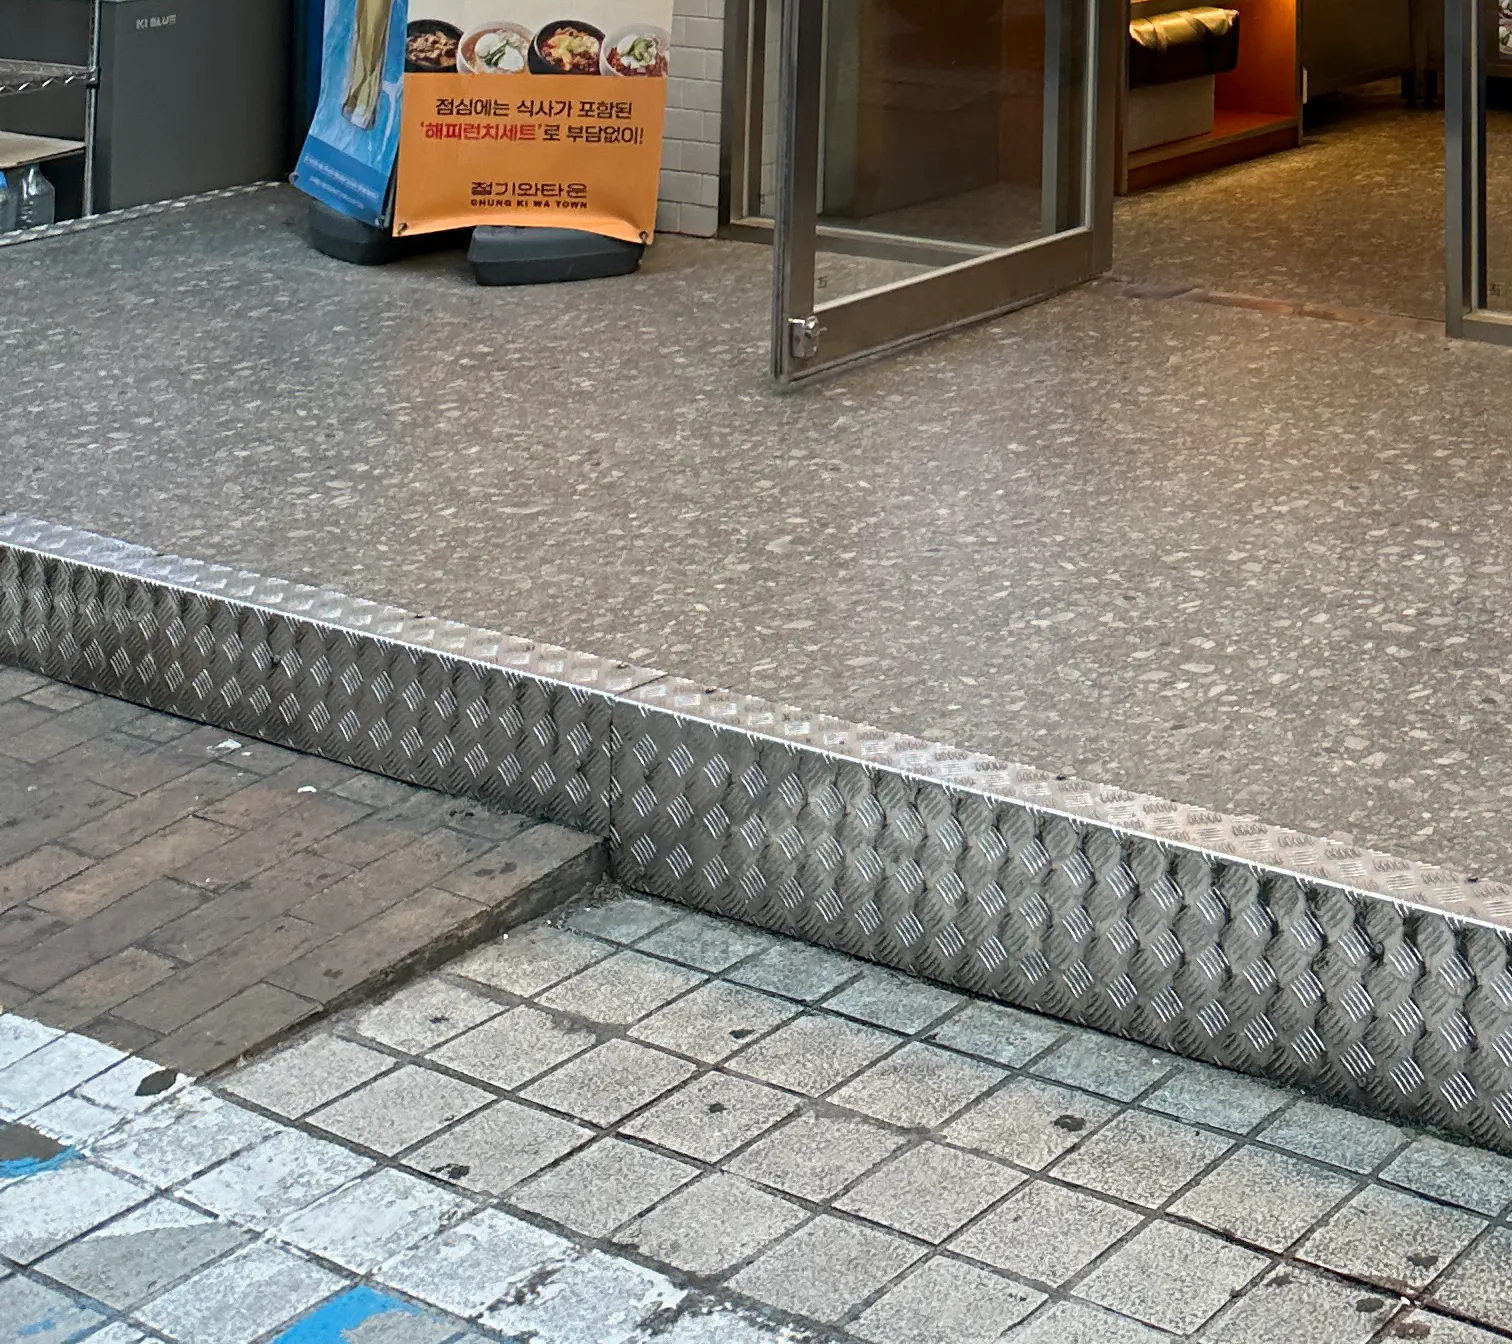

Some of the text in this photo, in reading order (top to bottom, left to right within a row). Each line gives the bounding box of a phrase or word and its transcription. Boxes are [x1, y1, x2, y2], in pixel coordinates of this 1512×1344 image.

[436, 99, 633, 119] 점심에는 식사가 포함된
[565, 124, 644, 144] 부담없이!
[470, 181, 588, 198] 청기와타운
[470, 198, 588, 209] CHUNG KI WA TOWN
